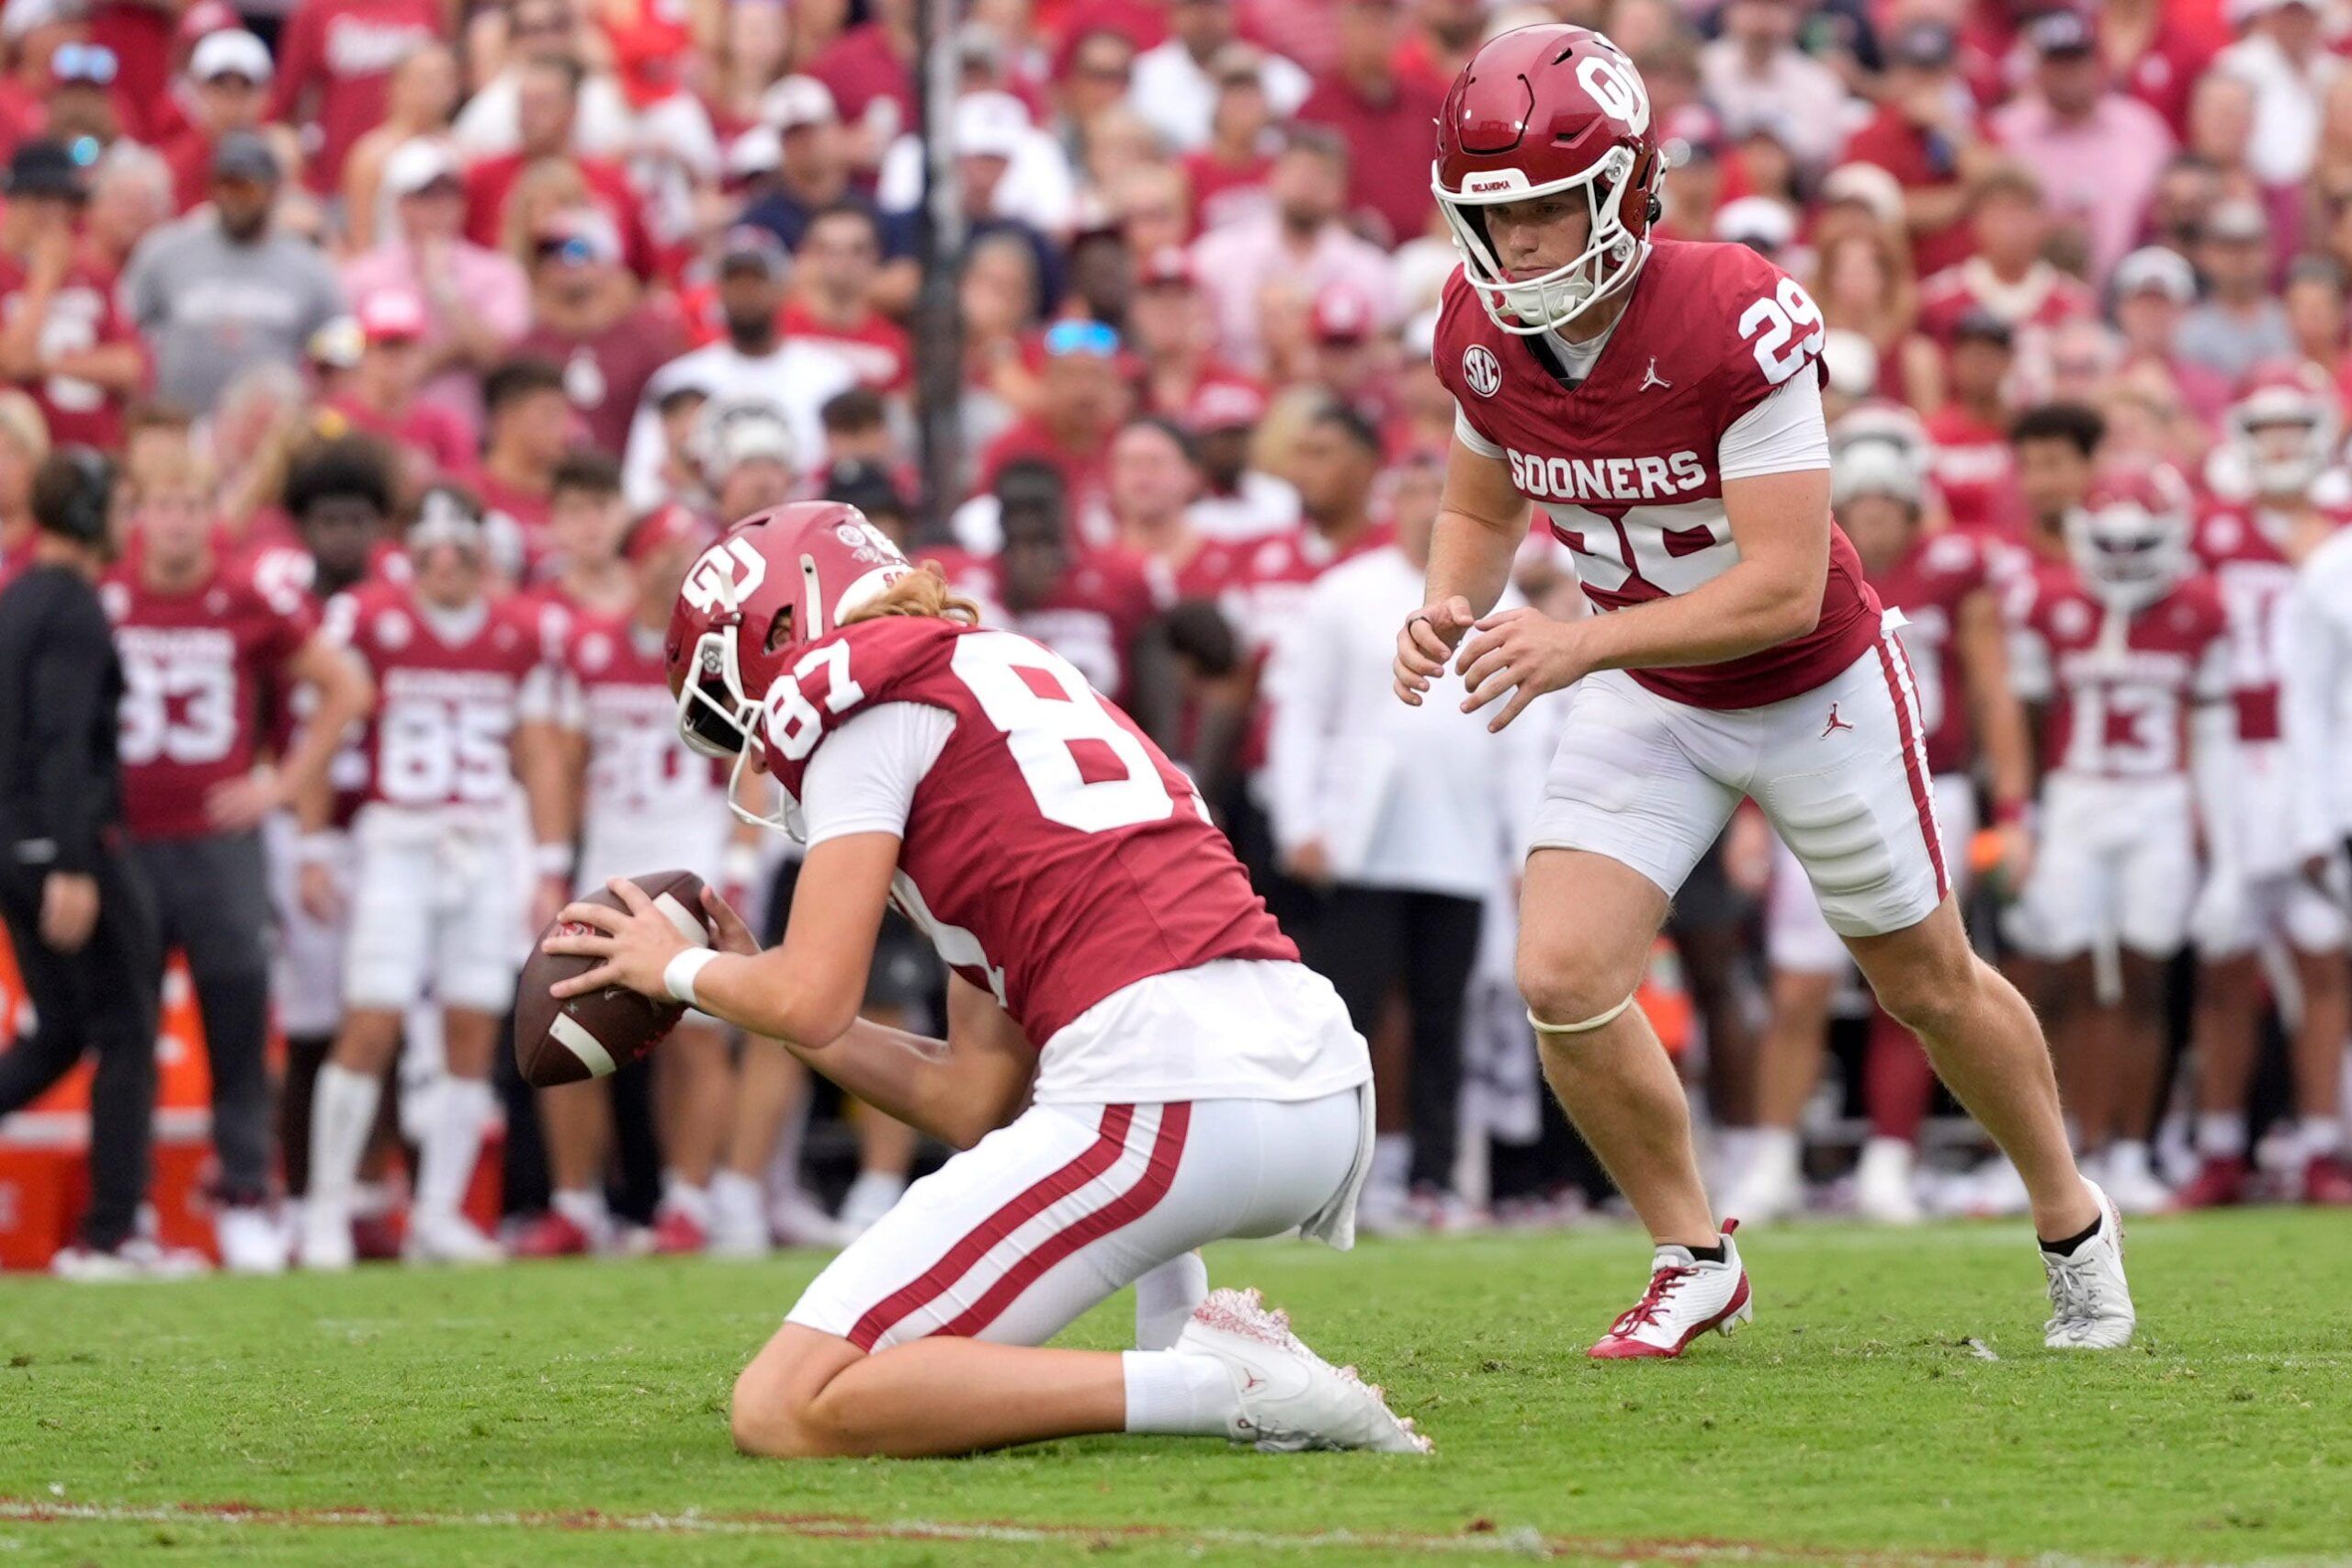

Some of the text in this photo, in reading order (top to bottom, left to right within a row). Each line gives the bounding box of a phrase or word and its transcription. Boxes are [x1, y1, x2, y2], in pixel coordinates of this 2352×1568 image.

[1471, 180, 1511, 193] OKLAHOMA
[1464, 348, 1498, 393] SEC
[1738, 276, 1825, 385] 29
[1507, 450, 1707, 499] SOONERS
[681, 536, 767, 614] OU
[763, 637, 865, 761] 87
[950, 629, 1217, 833] 8
[2067, 682, 2176, 770] 13
[379, 702, 514, 804] 85
